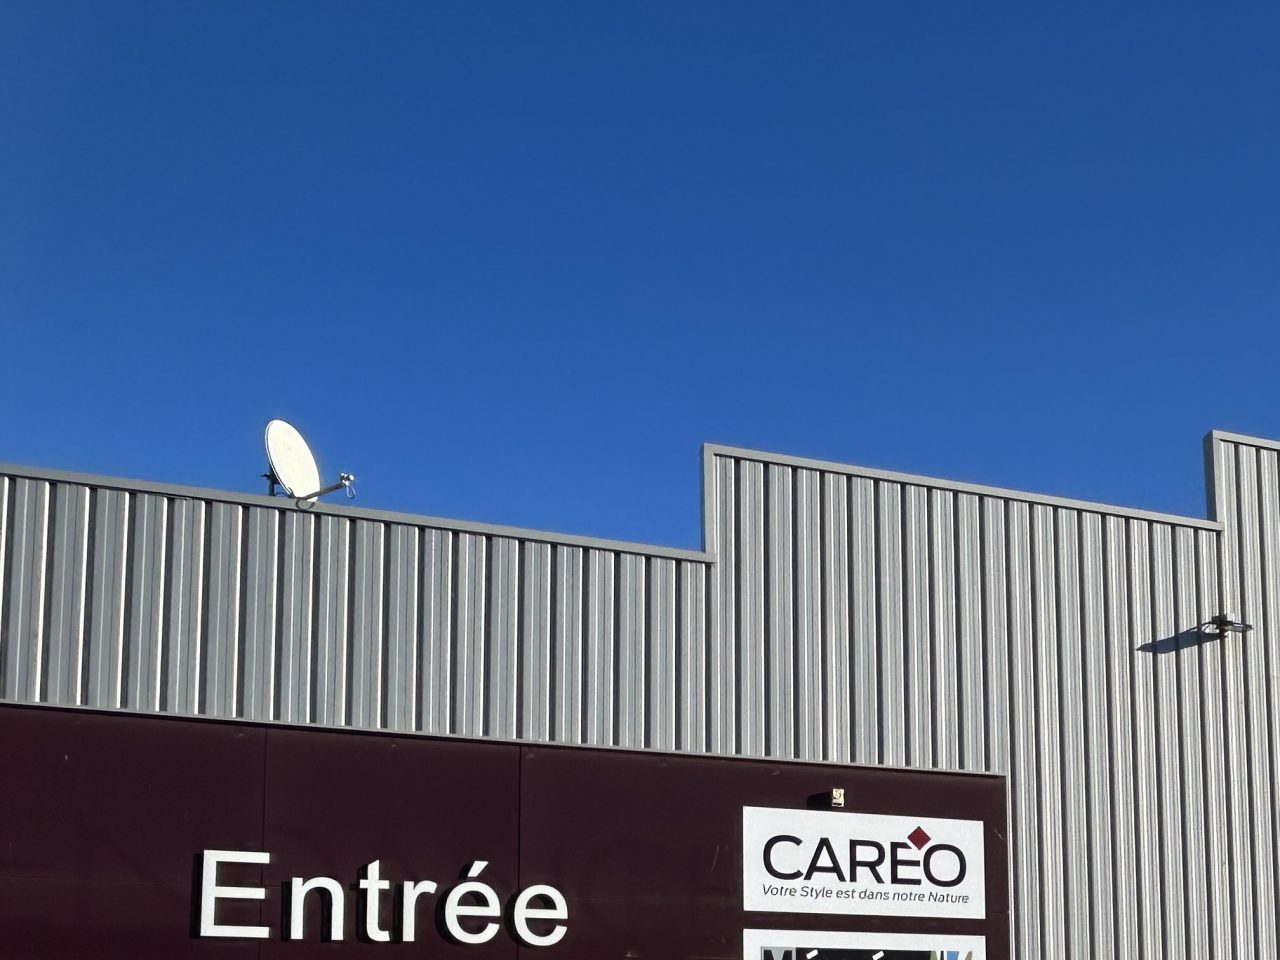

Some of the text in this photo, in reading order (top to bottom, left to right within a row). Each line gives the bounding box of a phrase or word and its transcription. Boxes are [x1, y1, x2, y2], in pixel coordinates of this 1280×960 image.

[200, 848, 569, 947] Entrée
[762, 883, 970, 904] Votre Style est dans notre Nature
